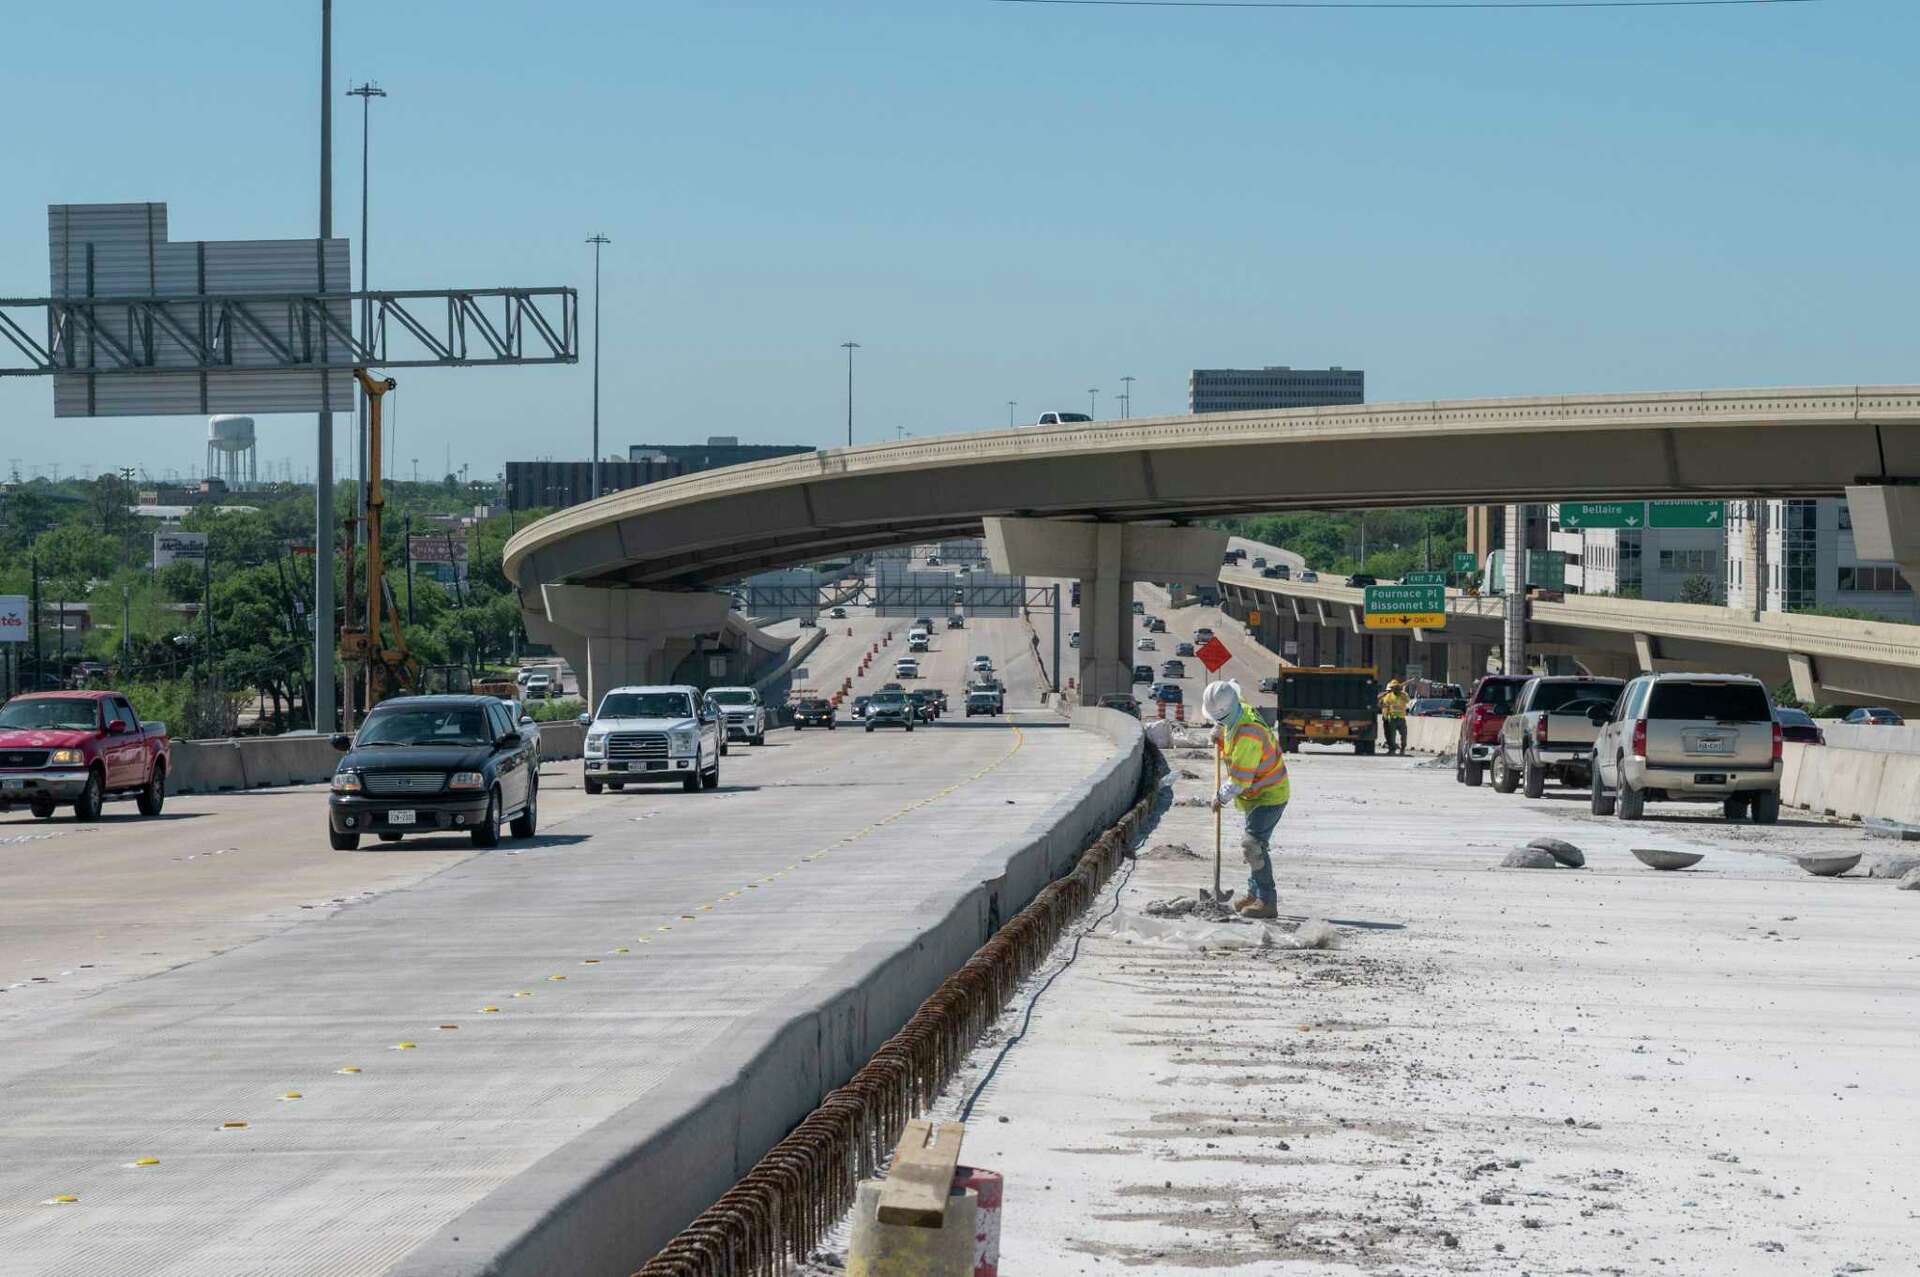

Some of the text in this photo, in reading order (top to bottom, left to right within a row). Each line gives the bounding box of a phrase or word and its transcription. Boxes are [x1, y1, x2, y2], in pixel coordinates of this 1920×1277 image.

[1582, 504, 1623, 514] Bellaire
[1436, 574, 1442, 582] A
[1372, 589, 1437, 598] Fournace Pl
[1371, 601, 1439, 610] Bissonnet St
[1379, 616, 1434, 625] EXIT ONLY
